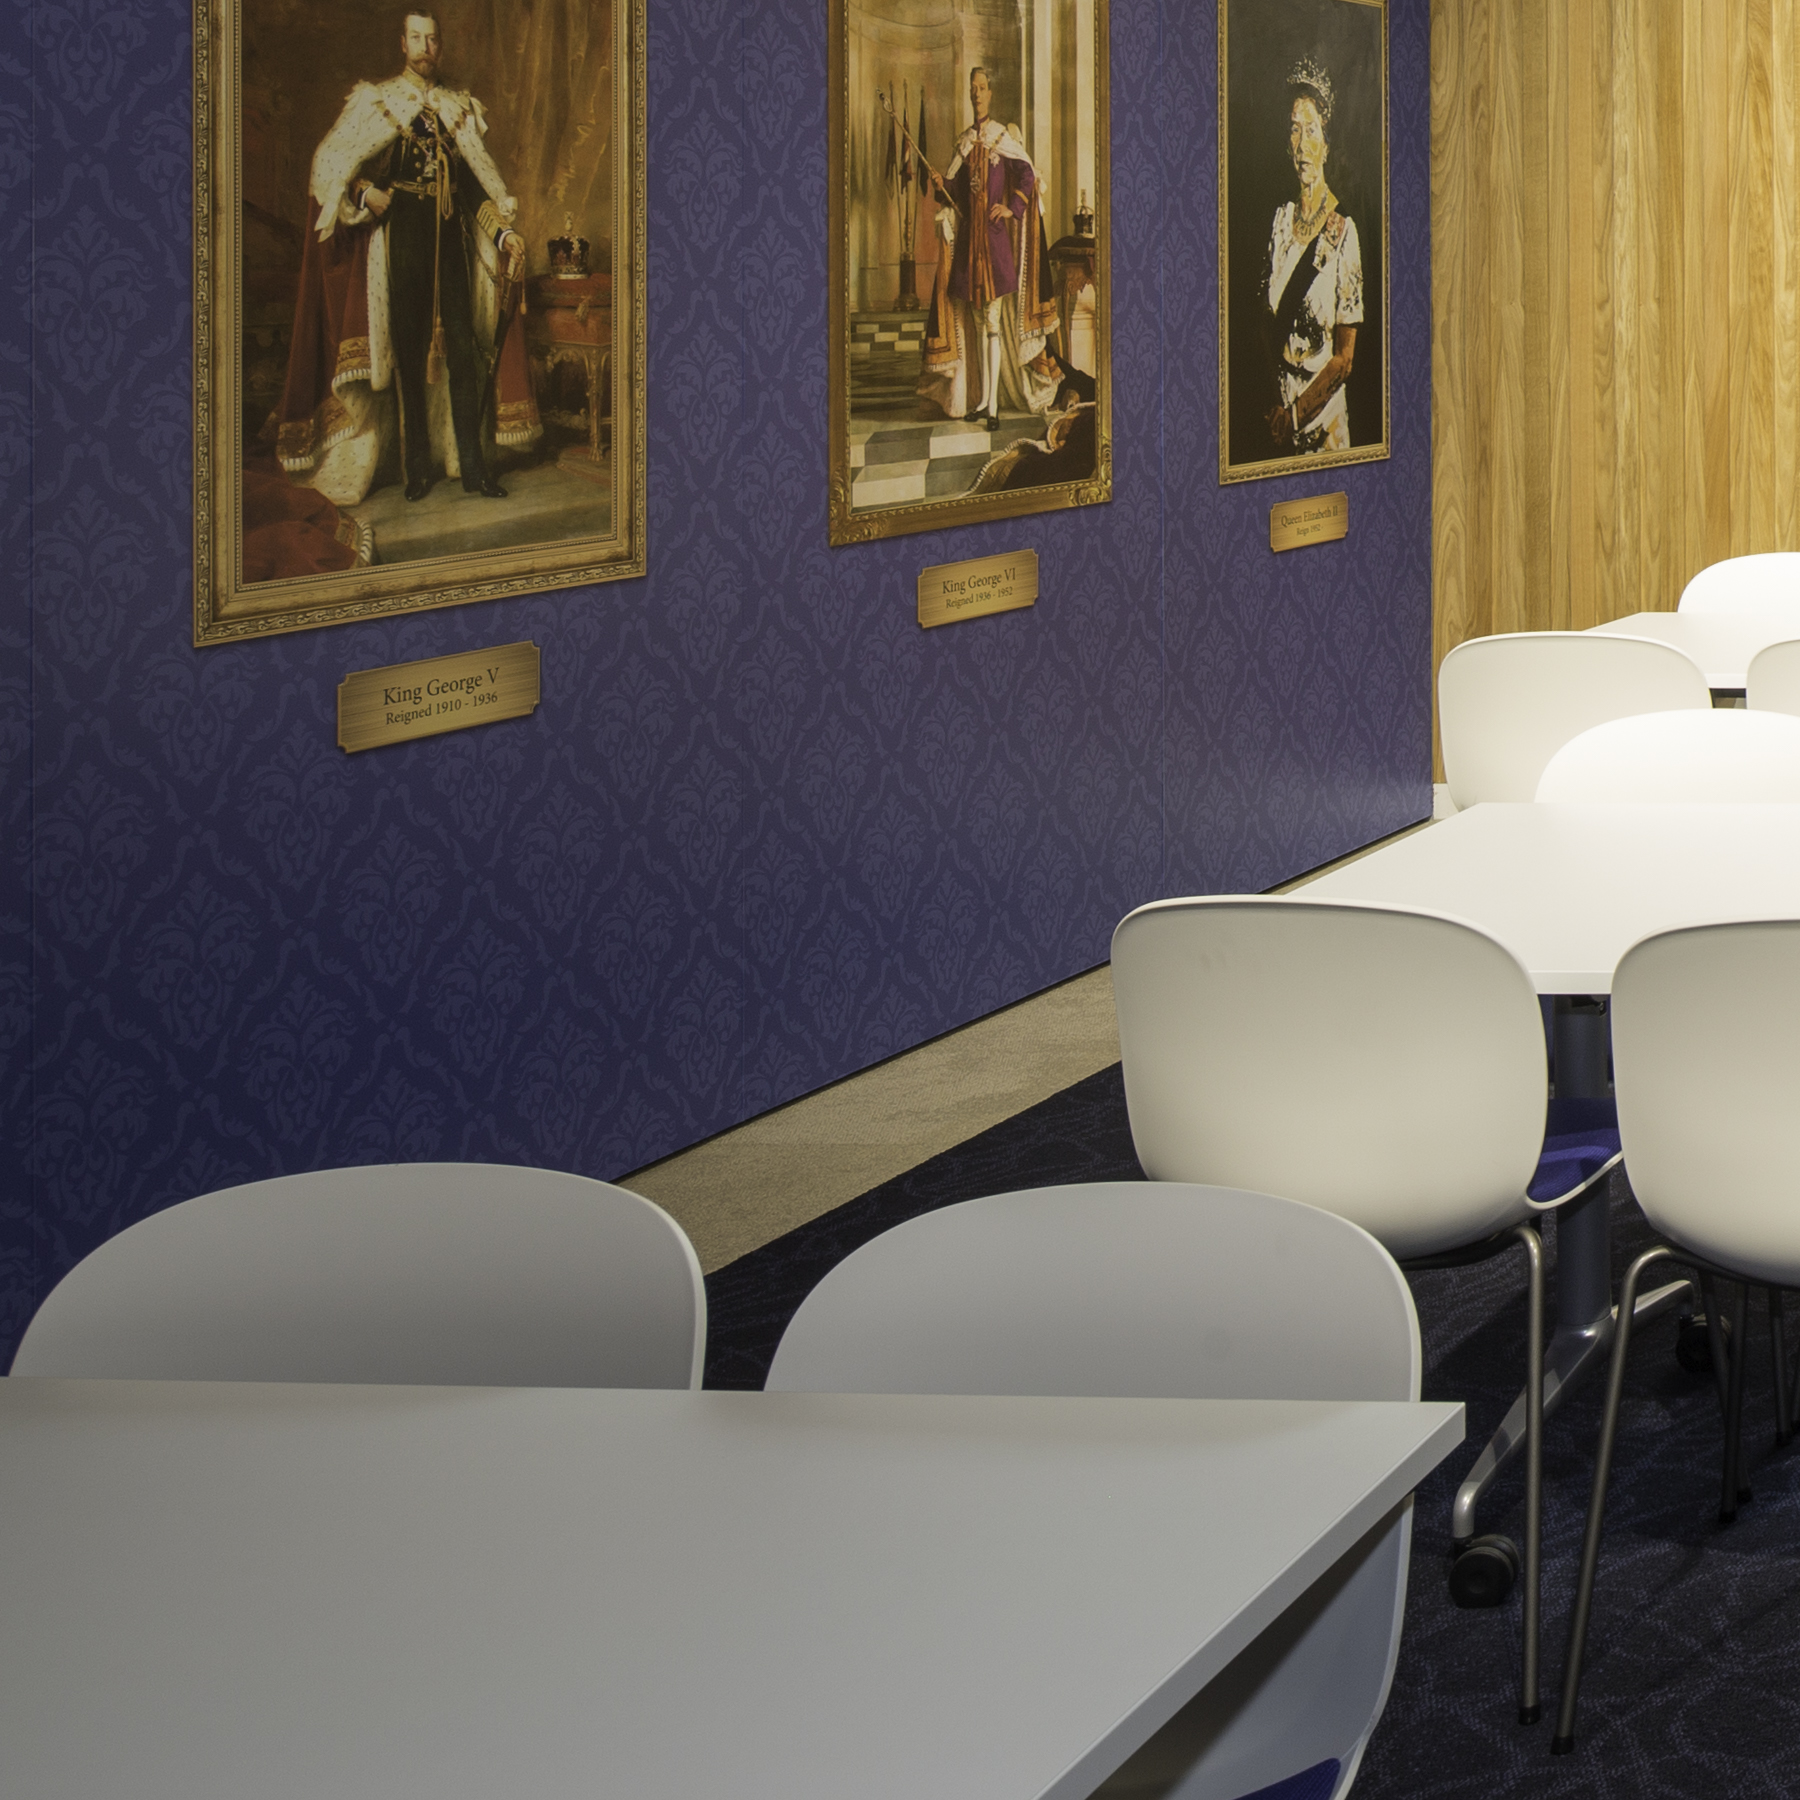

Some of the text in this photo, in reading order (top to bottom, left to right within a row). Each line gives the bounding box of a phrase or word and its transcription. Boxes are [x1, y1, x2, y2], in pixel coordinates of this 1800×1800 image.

[1303, 506, 1331, 522] Elizabeth
[942, 567, 1016, 594] King George VI
[946, 593, 974, 609] Reigned
[975, 591, 991, 602] 1936
[997, 586, 1013, 598] 1952
[383, 667, 500, 706] King George V
[386, 704, 432, 725] Reigned
[435, 698, 462, 715] 1910
[473, 692, 498, 708] 1936
